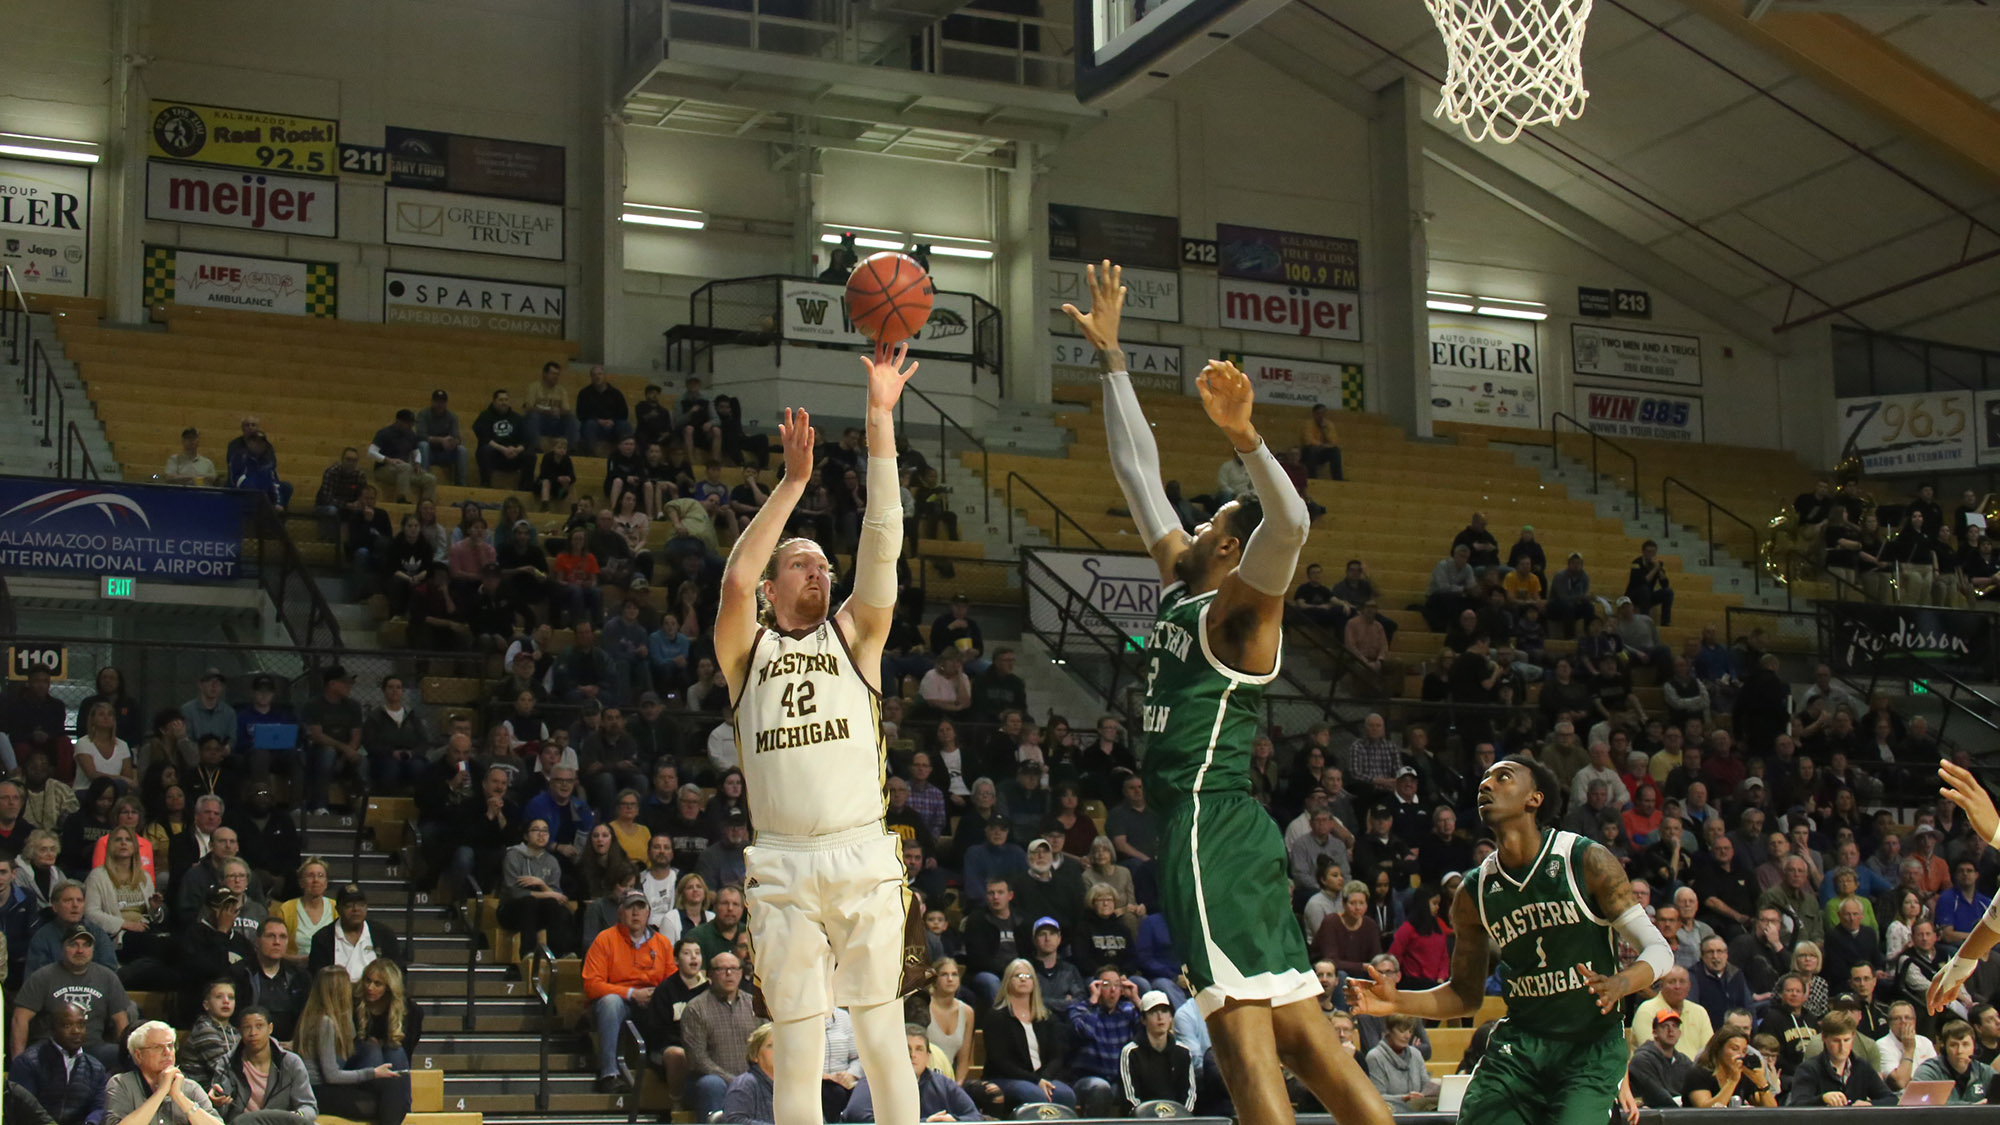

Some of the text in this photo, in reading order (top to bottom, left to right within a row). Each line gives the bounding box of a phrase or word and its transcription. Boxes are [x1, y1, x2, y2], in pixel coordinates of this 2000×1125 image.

[214, 125, 333, 143] Real Rock!
[256, 146, 324, 171] 92.5
[343, 148, 383, 172] 211
[169, 175, 315, 228] meijer
[447, 206, 554, 232] GREENLEAF
[467, 225, 534, 246] TRUST
[27, 244, 58, 258] Jeep
[1185, 241, 1217, 261] 212
[1314, 251, 1354, 265] OLDIES
[199, 265, 241, 282] LIFE
[1284, 263, 1356, 287] 100.9 FM
[208, 293, 273, 307] AMBULANCE
[416, 284, 561, 316] SPARTAN
[1618, 293, 1646, 312] 213
[389, 307, 560, 335] PAPERBOARD COMPANY
[796, 297, 828, 325] W
[1226, 287, 1353, 336] meijer
[1440, 334, 1503, 347] AUTO GROUP
[1602, 337, 1621, 348] TWO
[1623, 340, 1641, 350] MEN
[1642, 342, 1661, 353] AND
[1663, 344, 1669, 353] A
[1056, 345, 1179, 372] SPATAN
[1261, 366, 1293, 381] LIFE
[1498, 387, 1519, 397] Jeep
[1589, 393, 1639, 421] WIN
[1882, 397, 1966, 442] 96.5
[1630, 426, 1654, 437] YOUR
[112, 536, 175, 554] BATTLE
[179, 539, 237, 558] CREEK
[153, 558, 235, 577] AIRPORT
[107, 578, 131, 597] EXIT
[17, 649, 59, 671] 110
[758, 652, 840, 686] WESTERN
[781, 679, 817, 718] 42
[755, 718, 850, 754] MICHIGAN
[415, 893, 429, 904] 10
[444, 921, 452, 933] 9
[1490, 900, 1581, 949] EASTERN
[1535, 935, 1548, 968] 1
[506, 983, 515, 995] 7
[424, 1057, 433, 1069] 5
[456, 1097, 466, 1110] 4
[616, 1096, 625, 1108] 4
